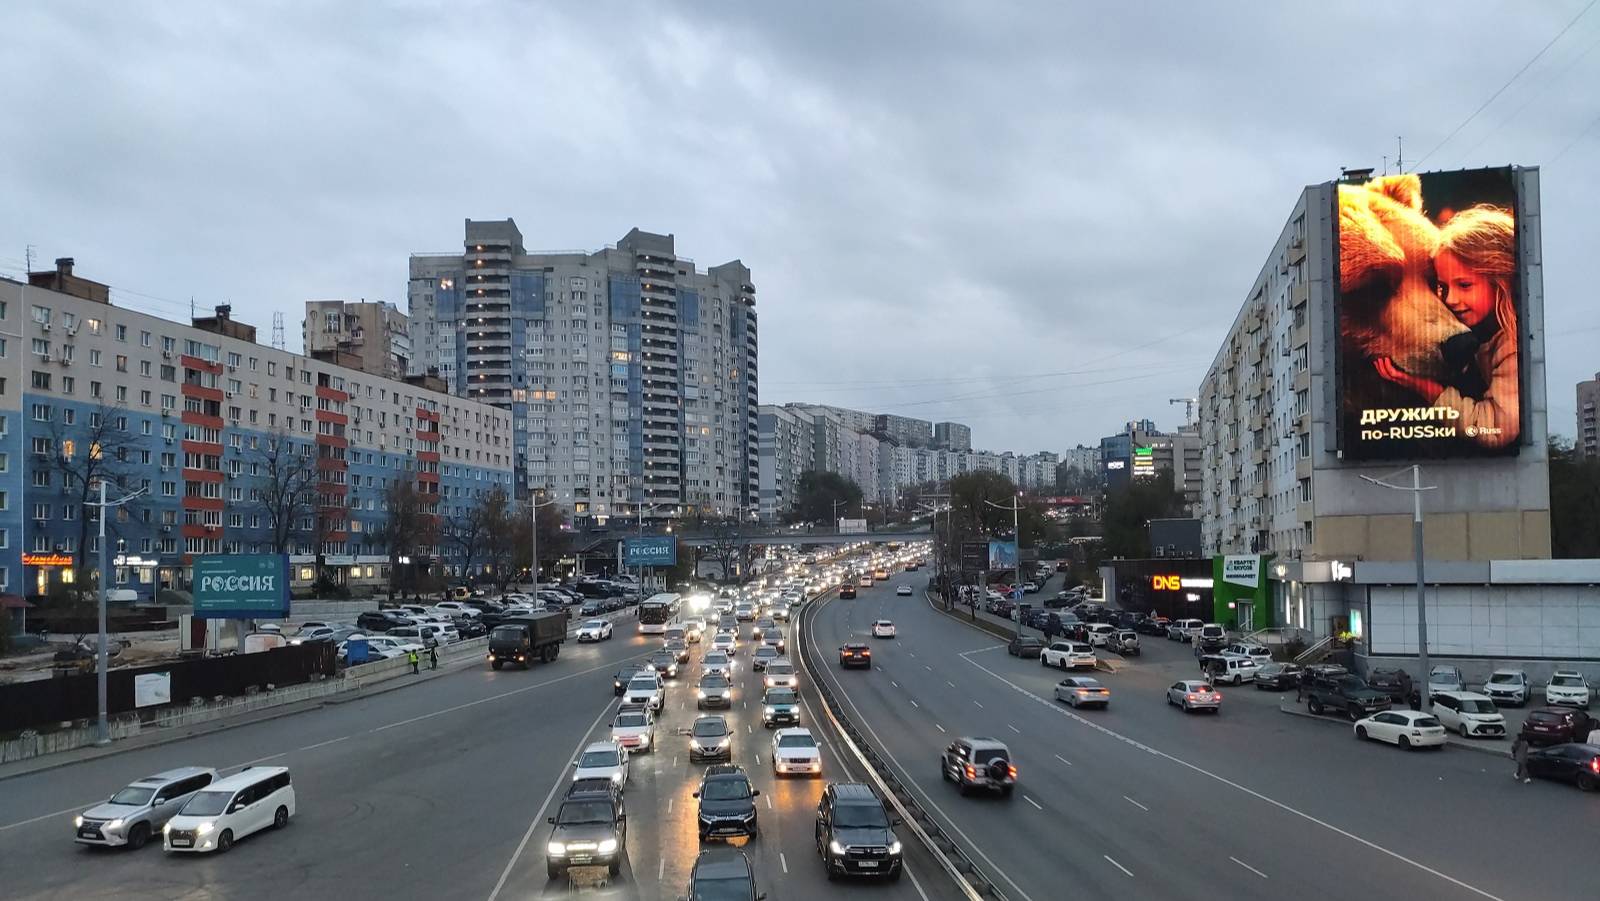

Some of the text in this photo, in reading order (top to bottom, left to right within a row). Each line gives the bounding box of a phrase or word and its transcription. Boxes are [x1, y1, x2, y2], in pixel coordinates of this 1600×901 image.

[1360, 406, 1460, 425] ДРУЖИТЬ
[1361, 425, 1456, 440] по-RUSSки
[200, 575, 275, 592] РОССИЯ
[1153, 575, 1180, 590] DNS
